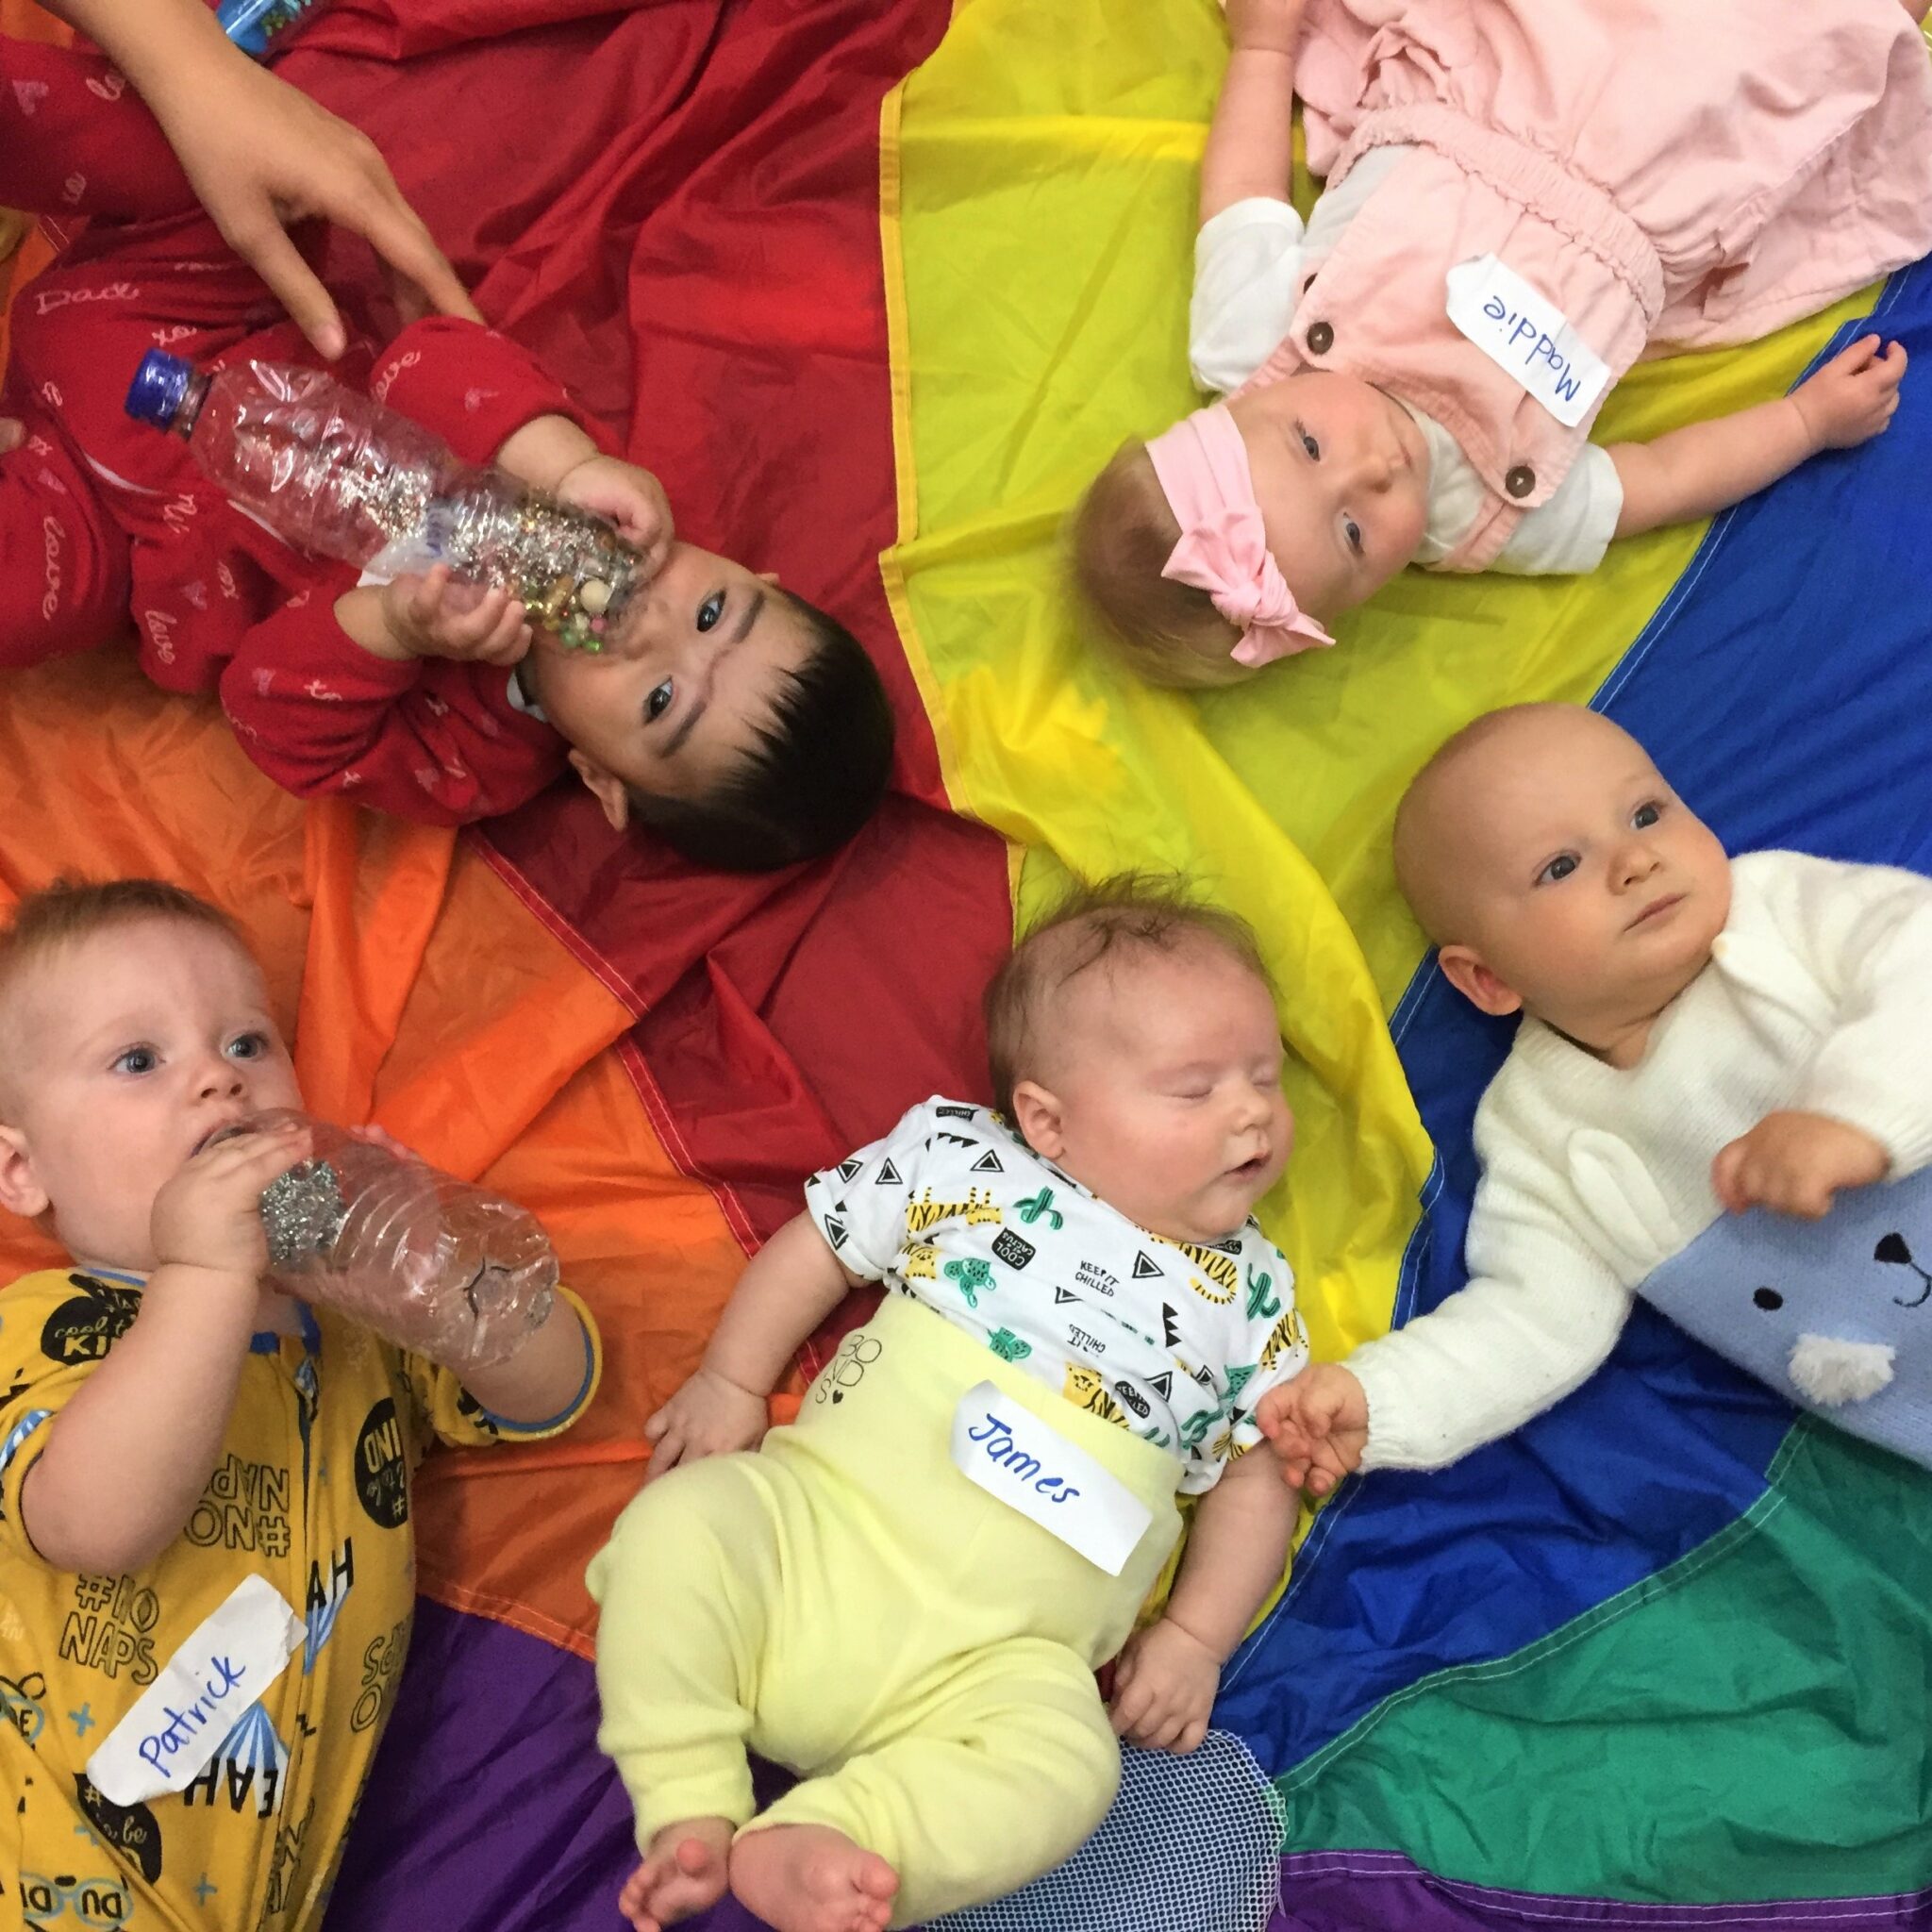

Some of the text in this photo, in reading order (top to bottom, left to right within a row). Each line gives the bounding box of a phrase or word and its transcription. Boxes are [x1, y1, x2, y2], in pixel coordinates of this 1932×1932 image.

[1482, 294, 1582, 402] Maddie
[42, 515, 66, 621] love
[996, 1241, 1025, 1267] COOL
[1002, 1231, 1035, 1257] CACTUS
[1079, 1259, 1121, 1286] KEEP IT
[1074, 1271, 1115, 1297] CHILLED
[62, 1335, 108, 1357] KI
[204, 1453, 290, 1513] NAP
[968, 1412, 1081, 1504] James
[58, 1610, 159, 1686] NAPS
[138, 1656, 246, 1779] Patrick
[183, 1756, 280, 1820] EAH
